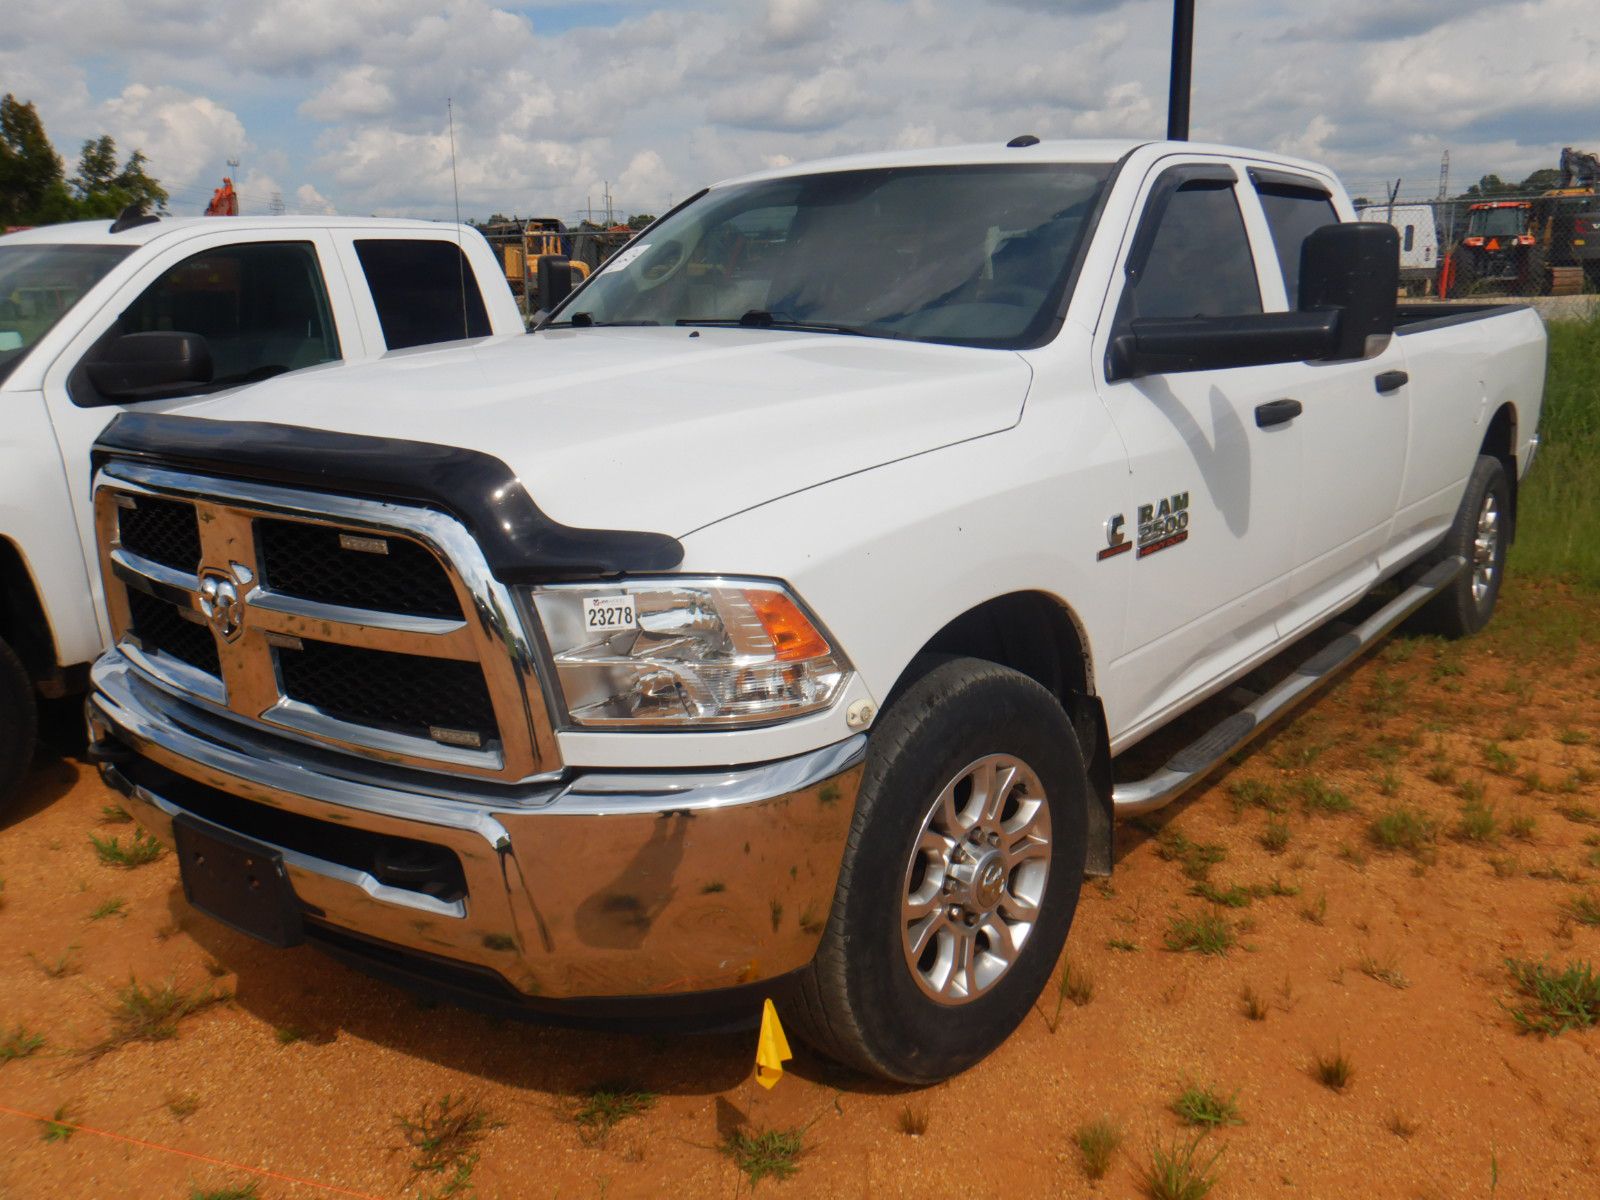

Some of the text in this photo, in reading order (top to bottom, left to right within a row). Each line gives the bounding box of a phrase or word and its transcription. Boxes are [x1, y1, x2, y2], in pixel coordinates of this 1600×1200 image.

[1137, 491, 1189, 524] RAM
[1138, 509, 1189, 545] 2500
[588, 606, 633, 626] 23278
